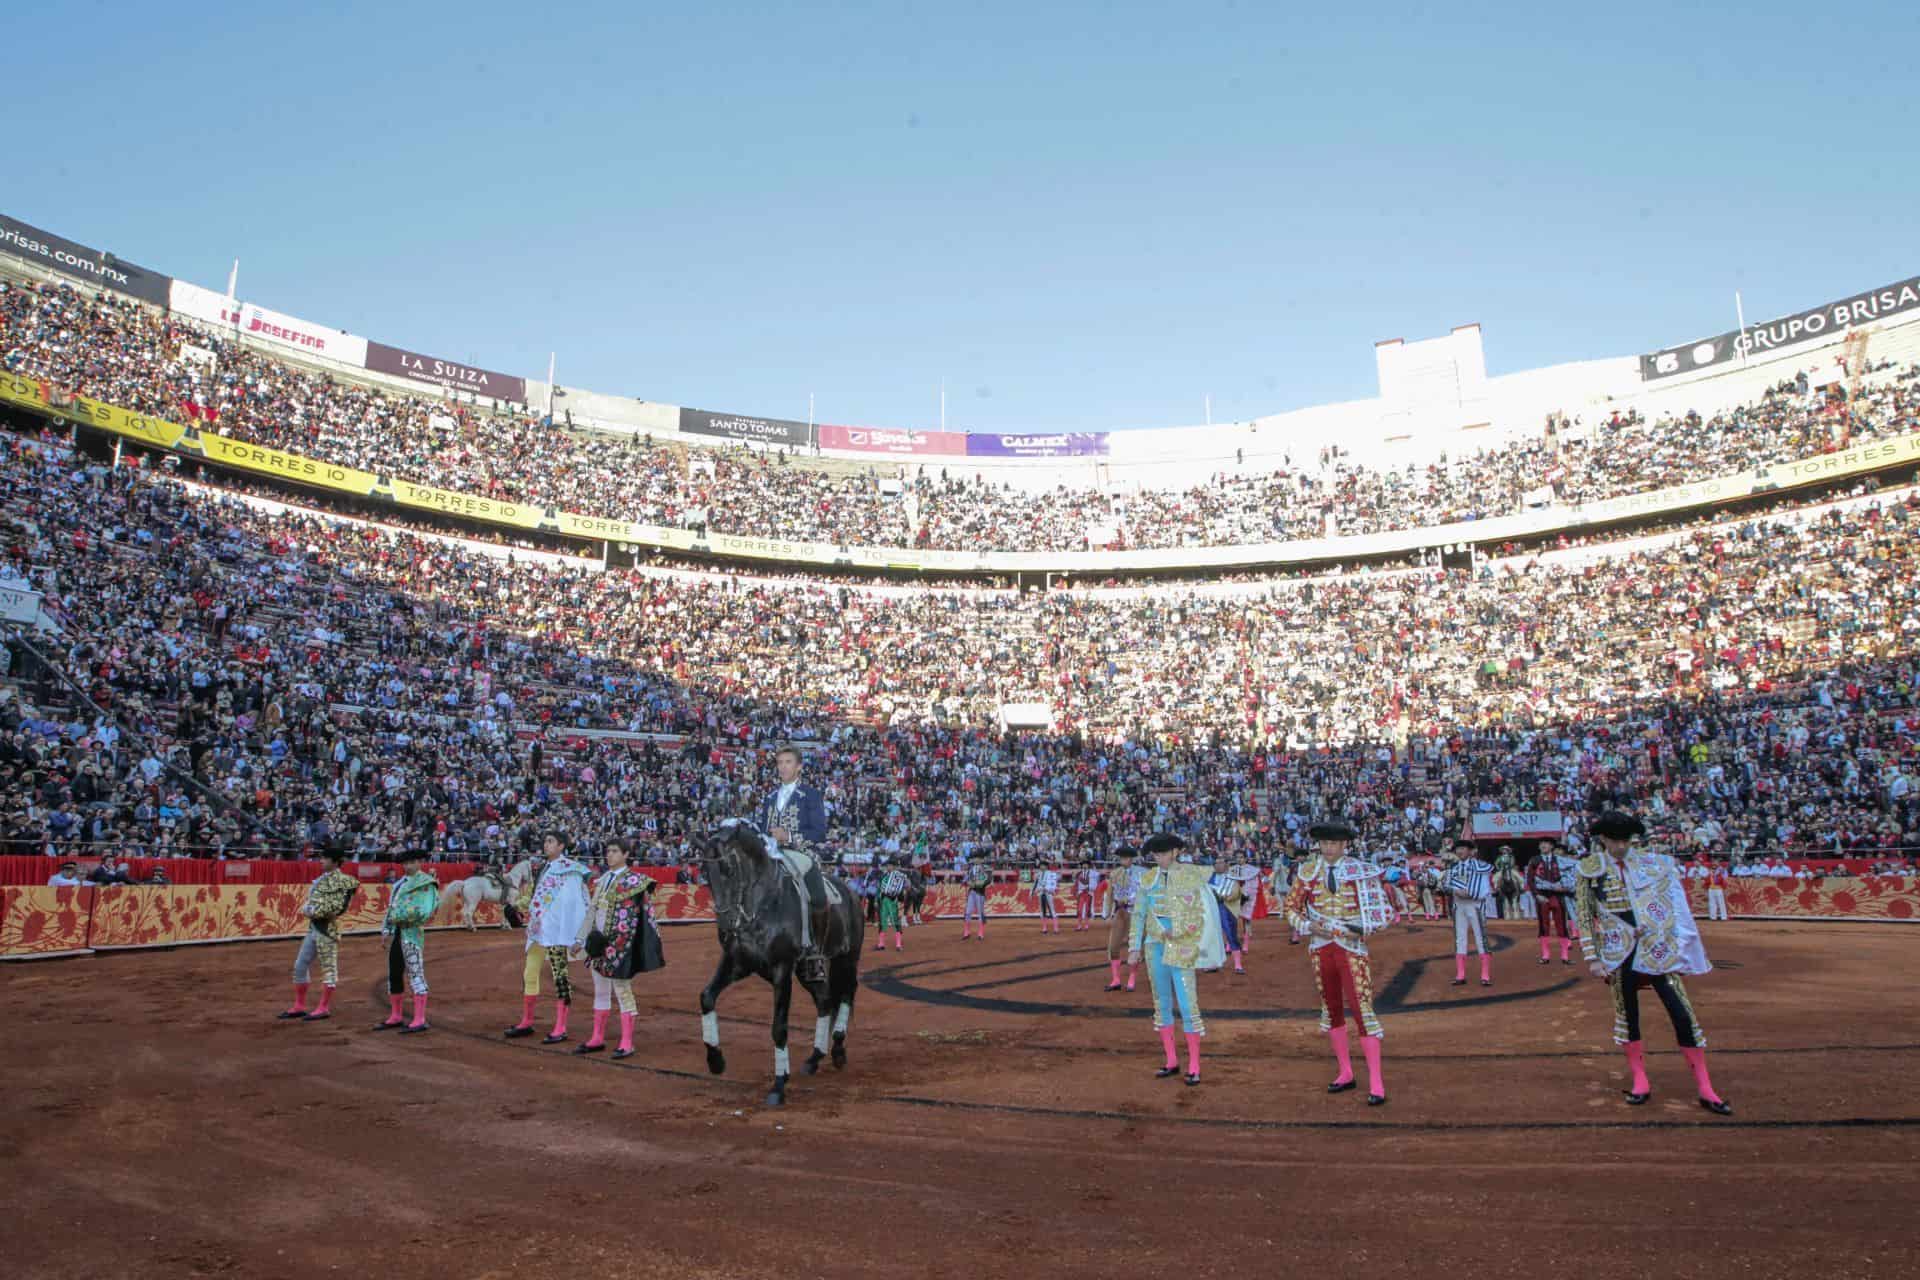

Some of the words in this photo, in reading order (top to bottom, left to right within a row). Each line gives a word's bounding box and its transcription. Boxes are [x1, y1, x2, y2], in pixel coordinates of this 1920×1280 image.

[1734, 313, 1826, 351] GRUPO
[1834, 283, 1920, 325] BRISA
[401, 355, 423, 370] LA
[433, 361, 489, 384] SUIZA
[710, 419, 748, 432] SANTO
[219, 441, 316, 475] TORRES
[1791, 444, 1898, 478] TORRES
[406, 486, 490, 512] TORRES
[571, 518, 641, 536] TORRE
[720, 538, 792, 554] TORRES
[1507, 815, 1538, 826] GNP
